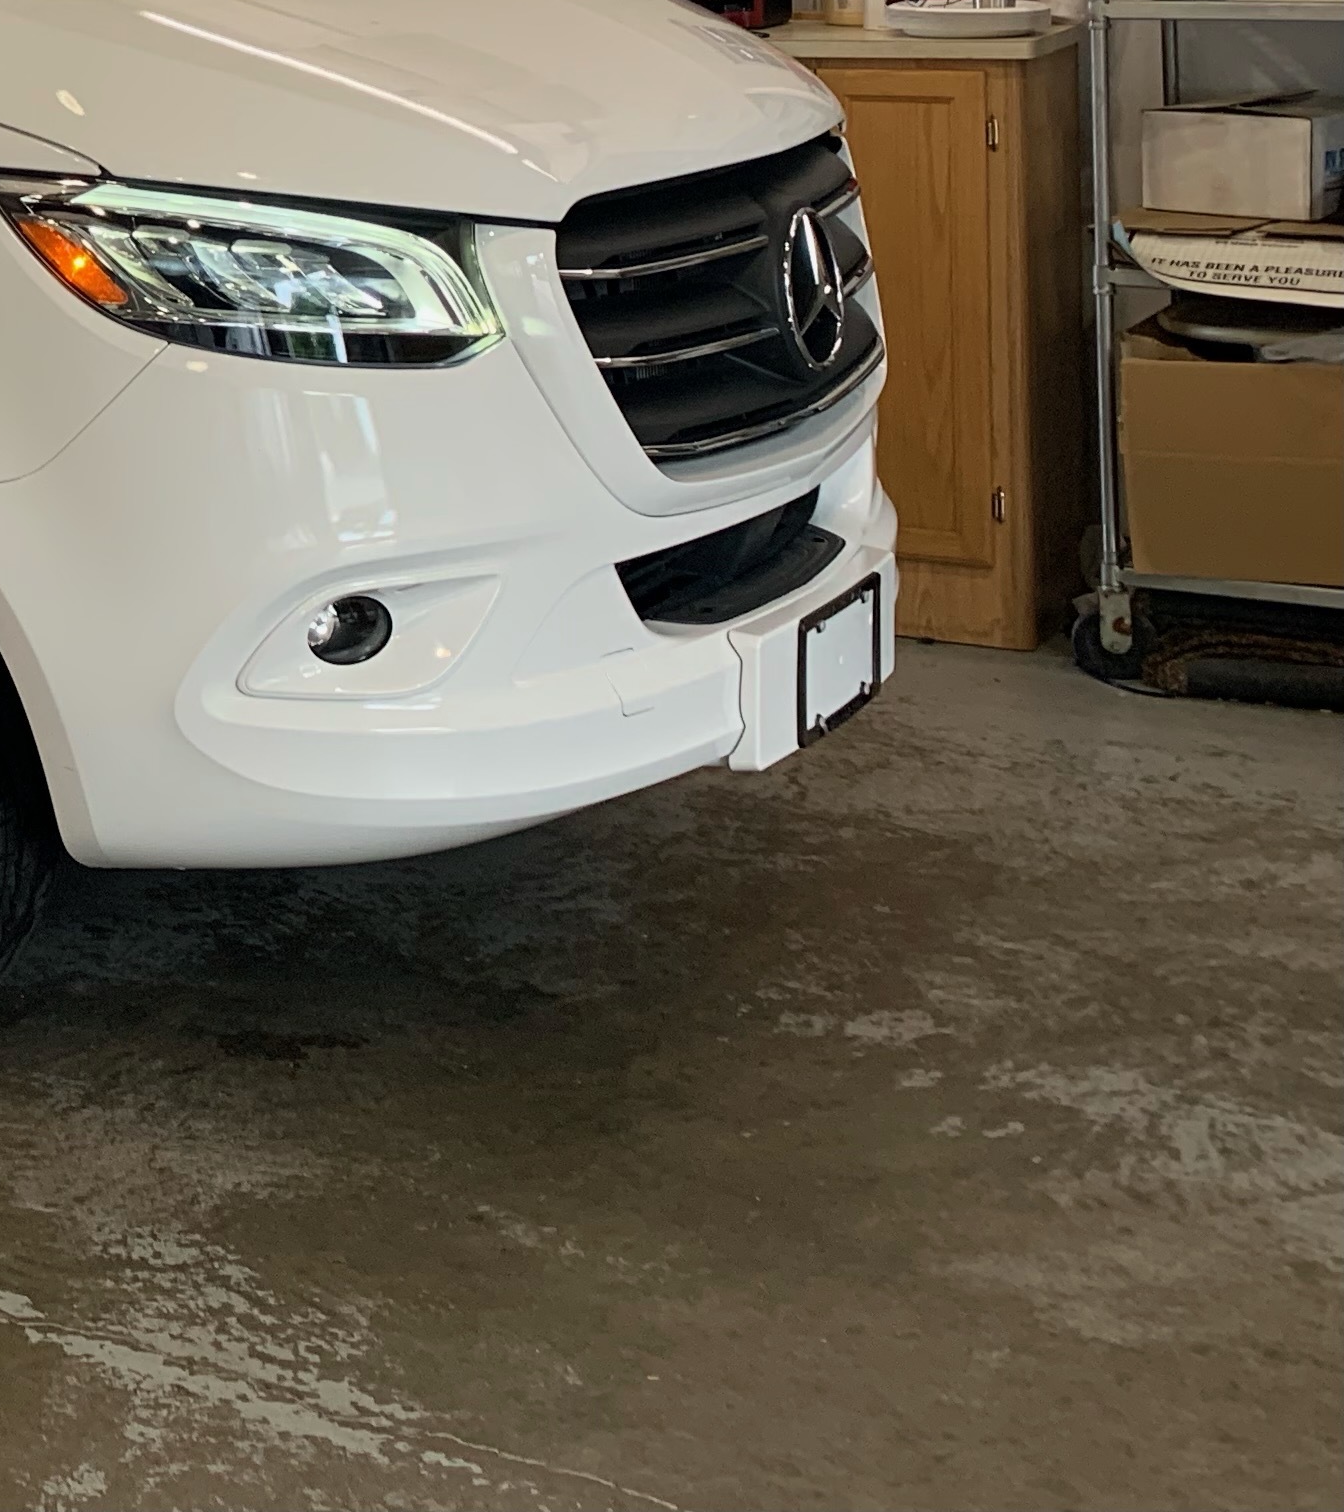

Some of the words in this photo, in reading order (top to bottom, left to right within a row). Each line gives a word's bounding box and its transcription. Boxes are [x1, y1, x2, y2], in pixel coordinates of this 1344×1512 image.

[1169, 258, 1202, 269] HAS
[1205, 261, 1246, 272] BEEN
[1249, 265, 1260, 273] A
[1189, 270, 1207, 279] TO
[1212, 272, 1261, 284] SERVE
[1266, 276, 1301, 286] YOU
